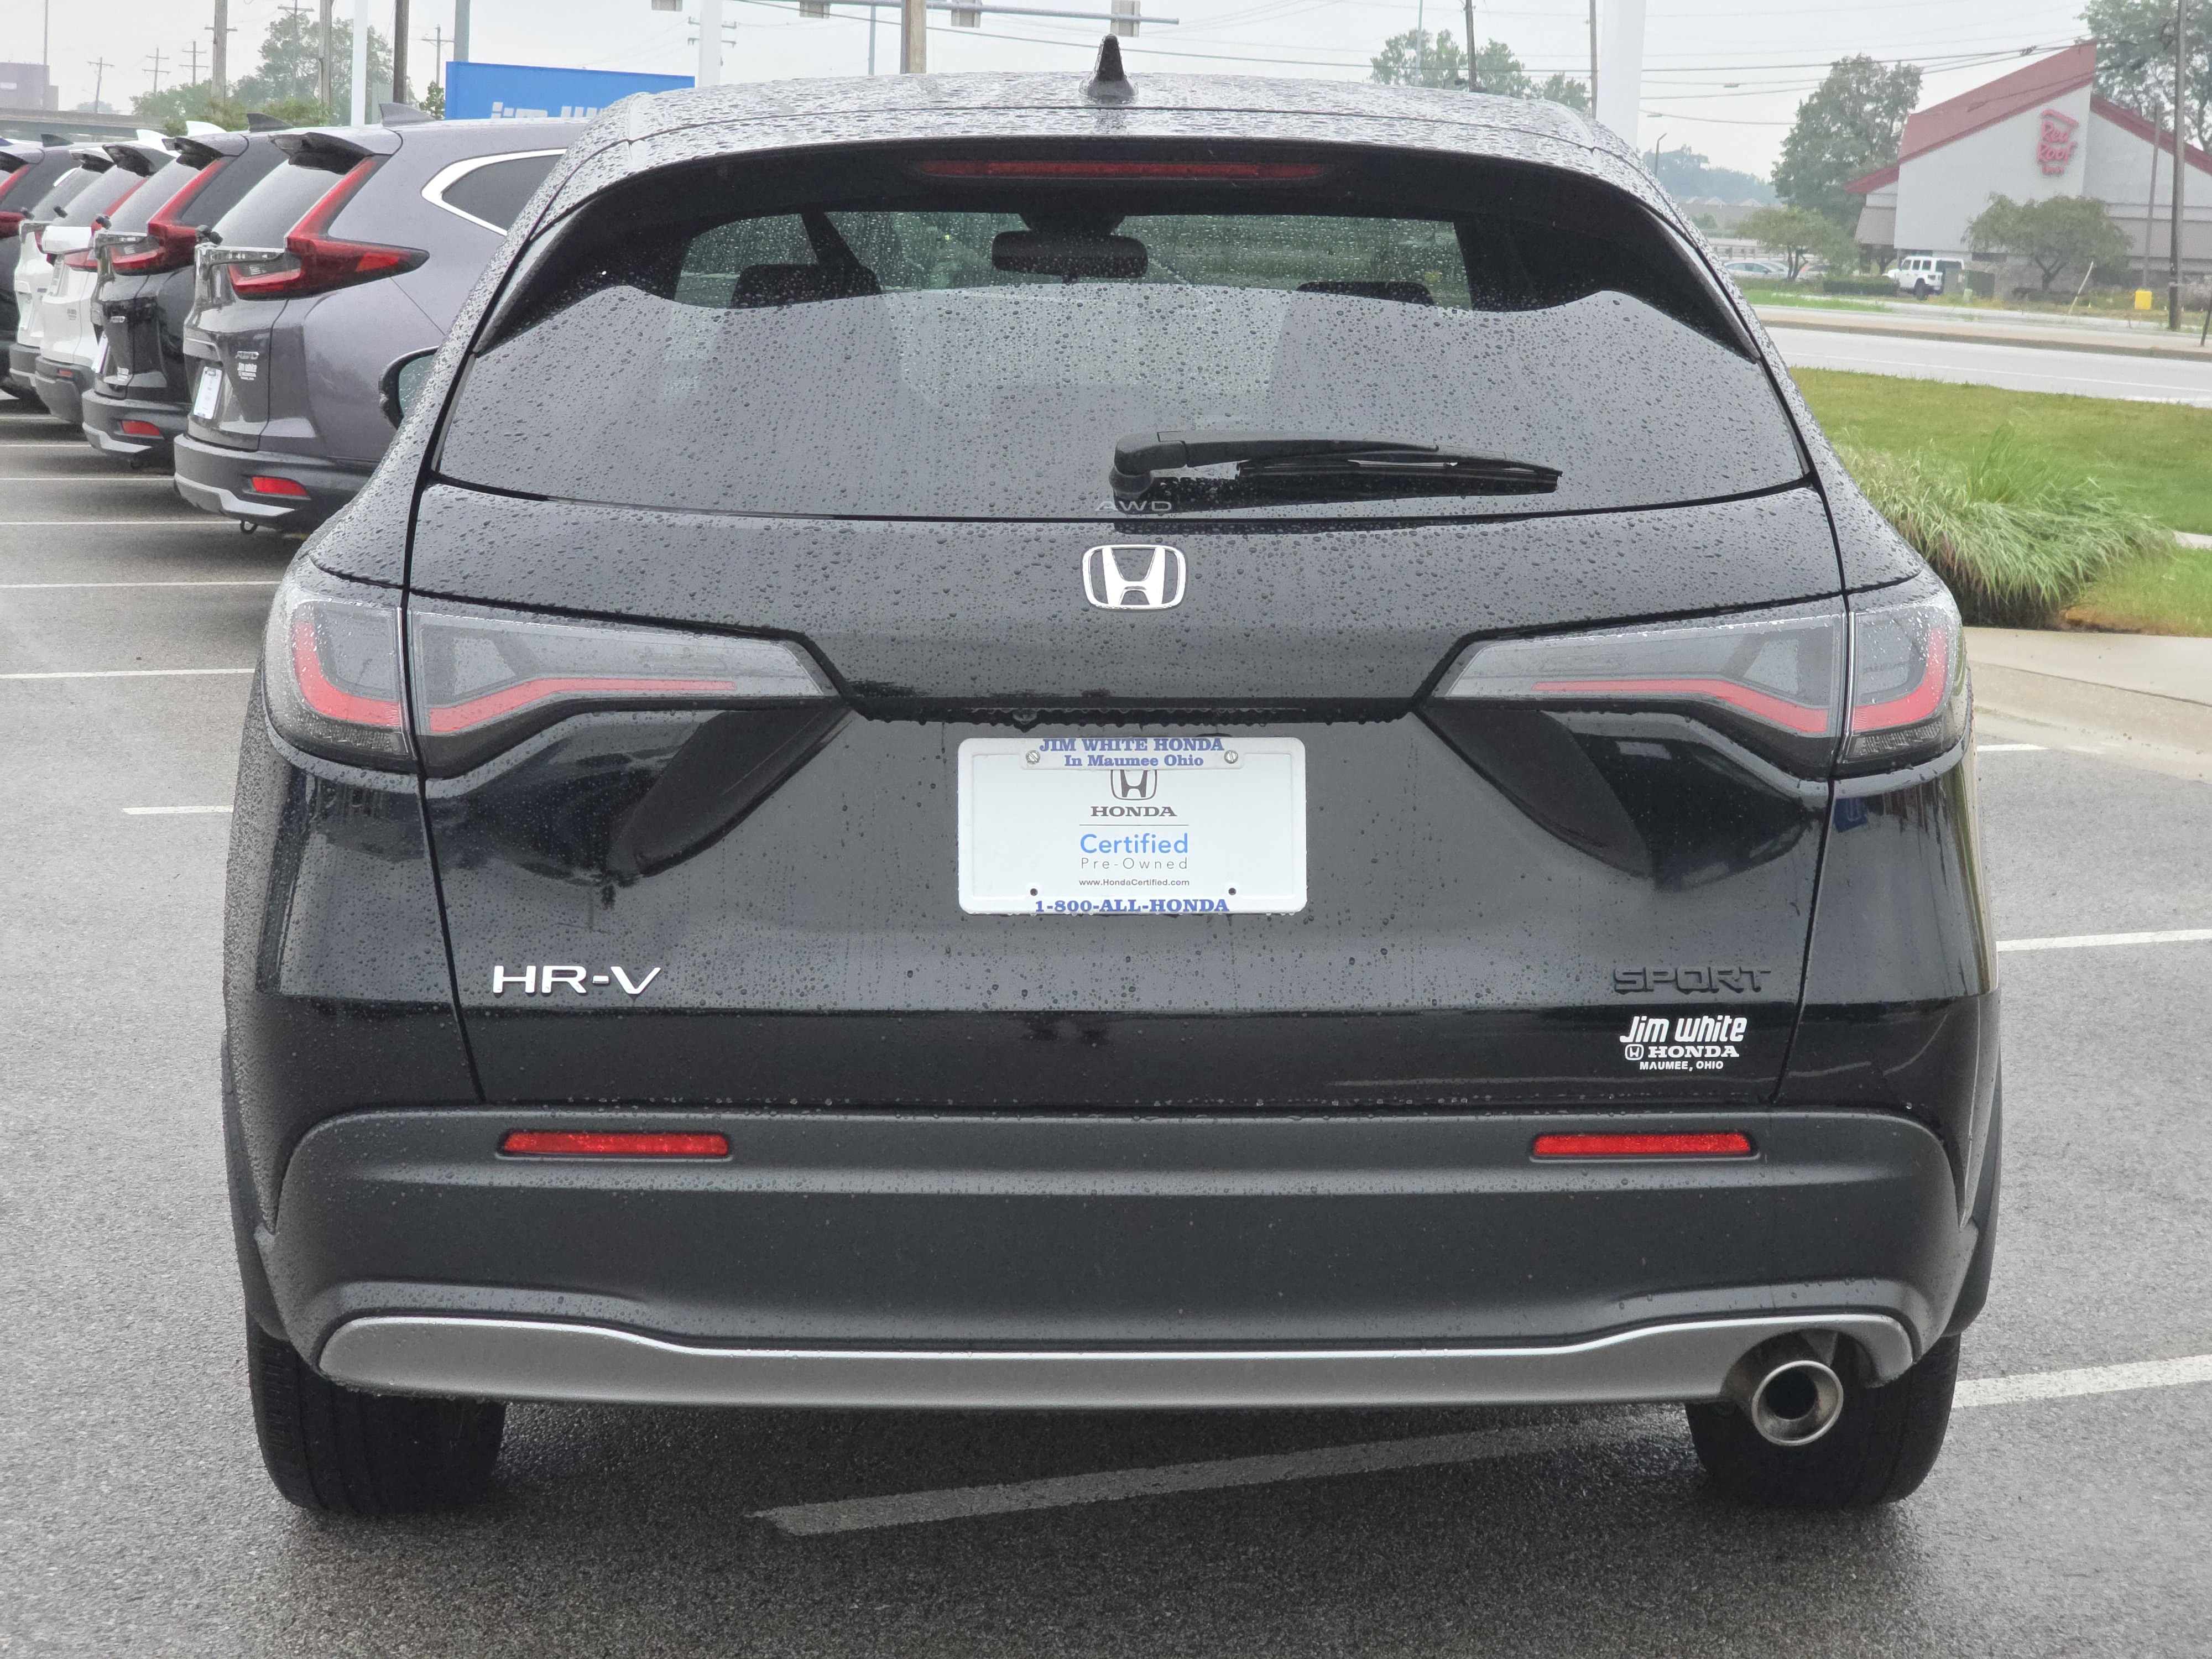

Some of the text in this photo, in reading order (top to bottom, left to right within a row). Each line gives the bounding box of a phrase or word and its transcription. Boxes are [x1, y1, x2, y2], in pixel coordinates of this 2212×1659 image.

[2041, 120, 2070, 143] Red
[2036, 140, 2078, 164] Roof
[1094, 500, 1172, 512] AWD
[1039, 738, 1225, 752] JIM WHITE HONDA
[1065, 754, 1204, 766] In Maumee Ohio
[1090, 806, 1178, 817] HONDA
[1080, 832, 1188, 854] Certified
[1081, 857, 1188, 869] Pre-Owned
[1078, 878, 1190, 886] www.HondaCertified.com
[1035, 899, 1230, 912] 1-800-ALL-HONDA
[492, 965, 661, 994] HR-V
[1613, 966, 1772, 993] SPORT
[1619, 1015, 1670, 1043] Jim
[1647, 1046, 1740, 1058] HONDA
[1639, 1060, 1724, 1072] MAUMEE, OHIO
